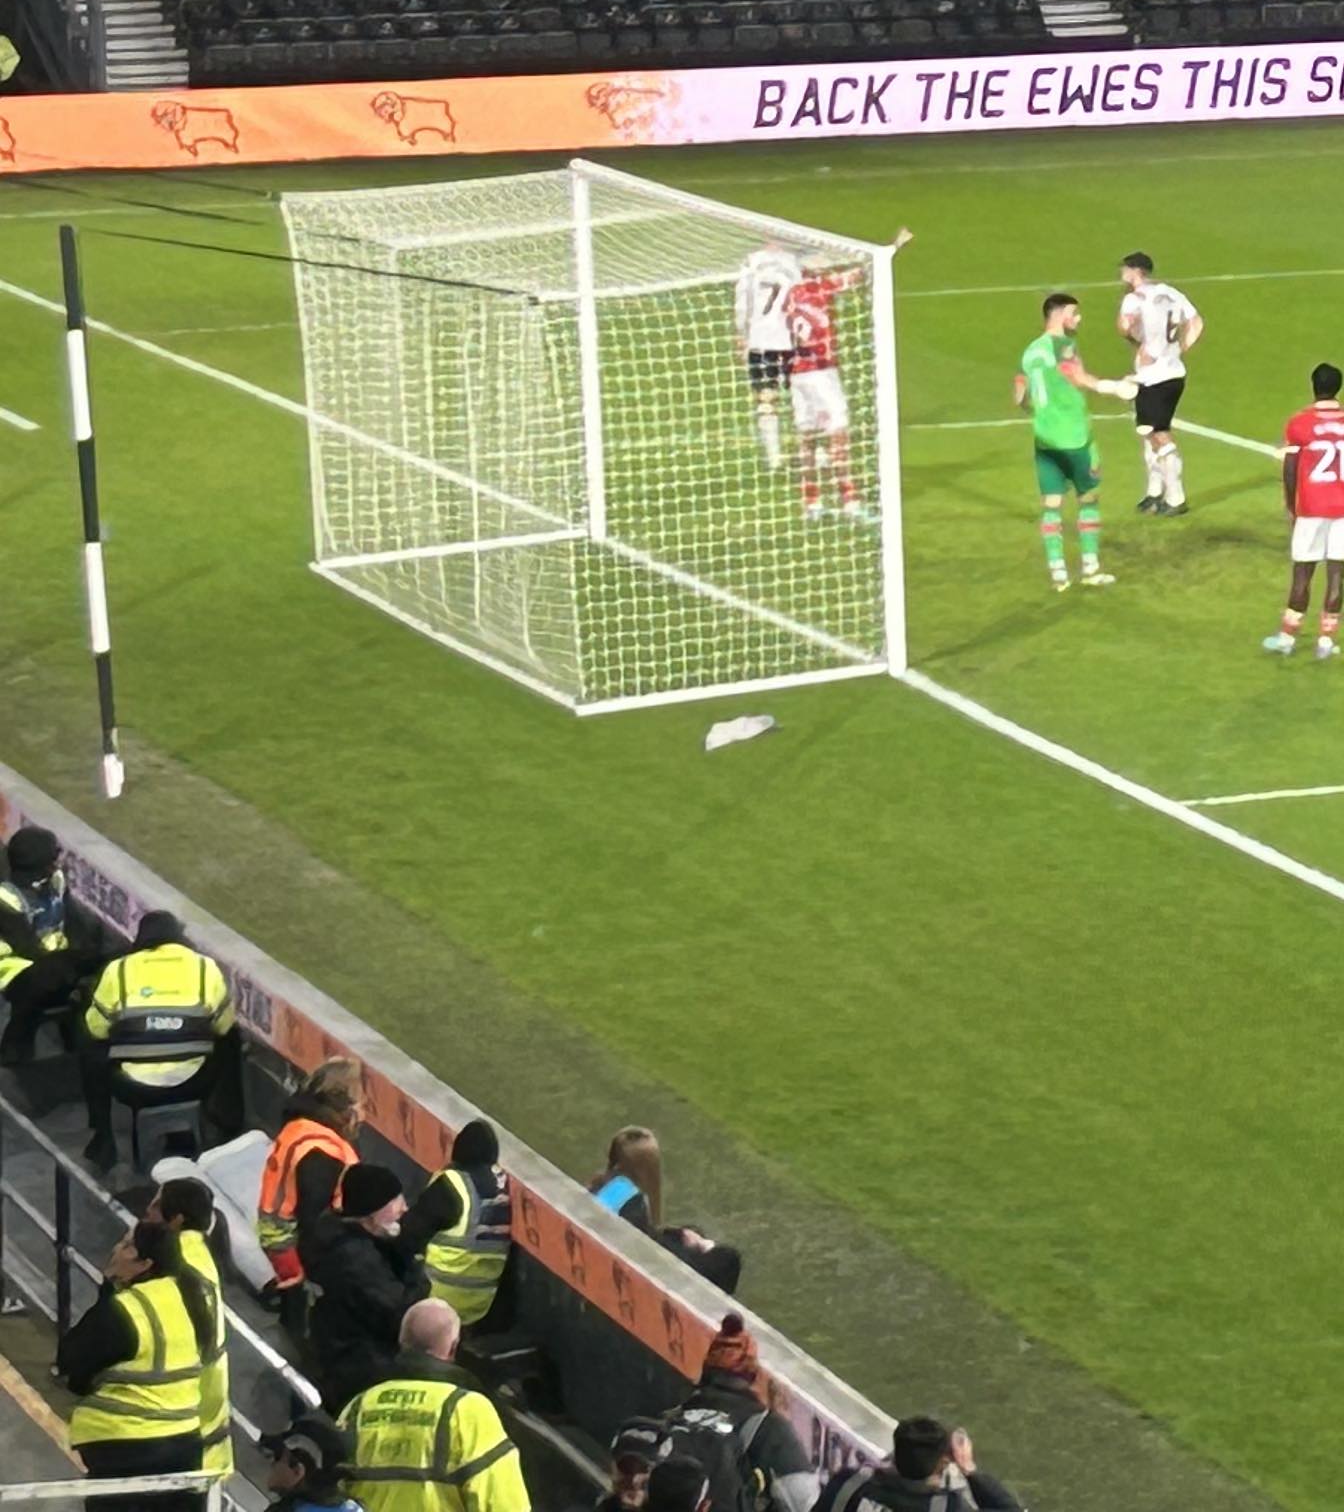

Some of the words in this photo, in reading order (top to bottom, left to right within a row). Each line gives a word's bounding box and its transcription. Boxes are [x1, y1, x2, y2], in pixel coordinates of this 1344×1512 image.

[754, 74, 899, 129] BACK
[916, 69, 1010, 122] THE
[1028, 62, 1163, 116] EWES
[1182, 57, 1290, 109] THIS
